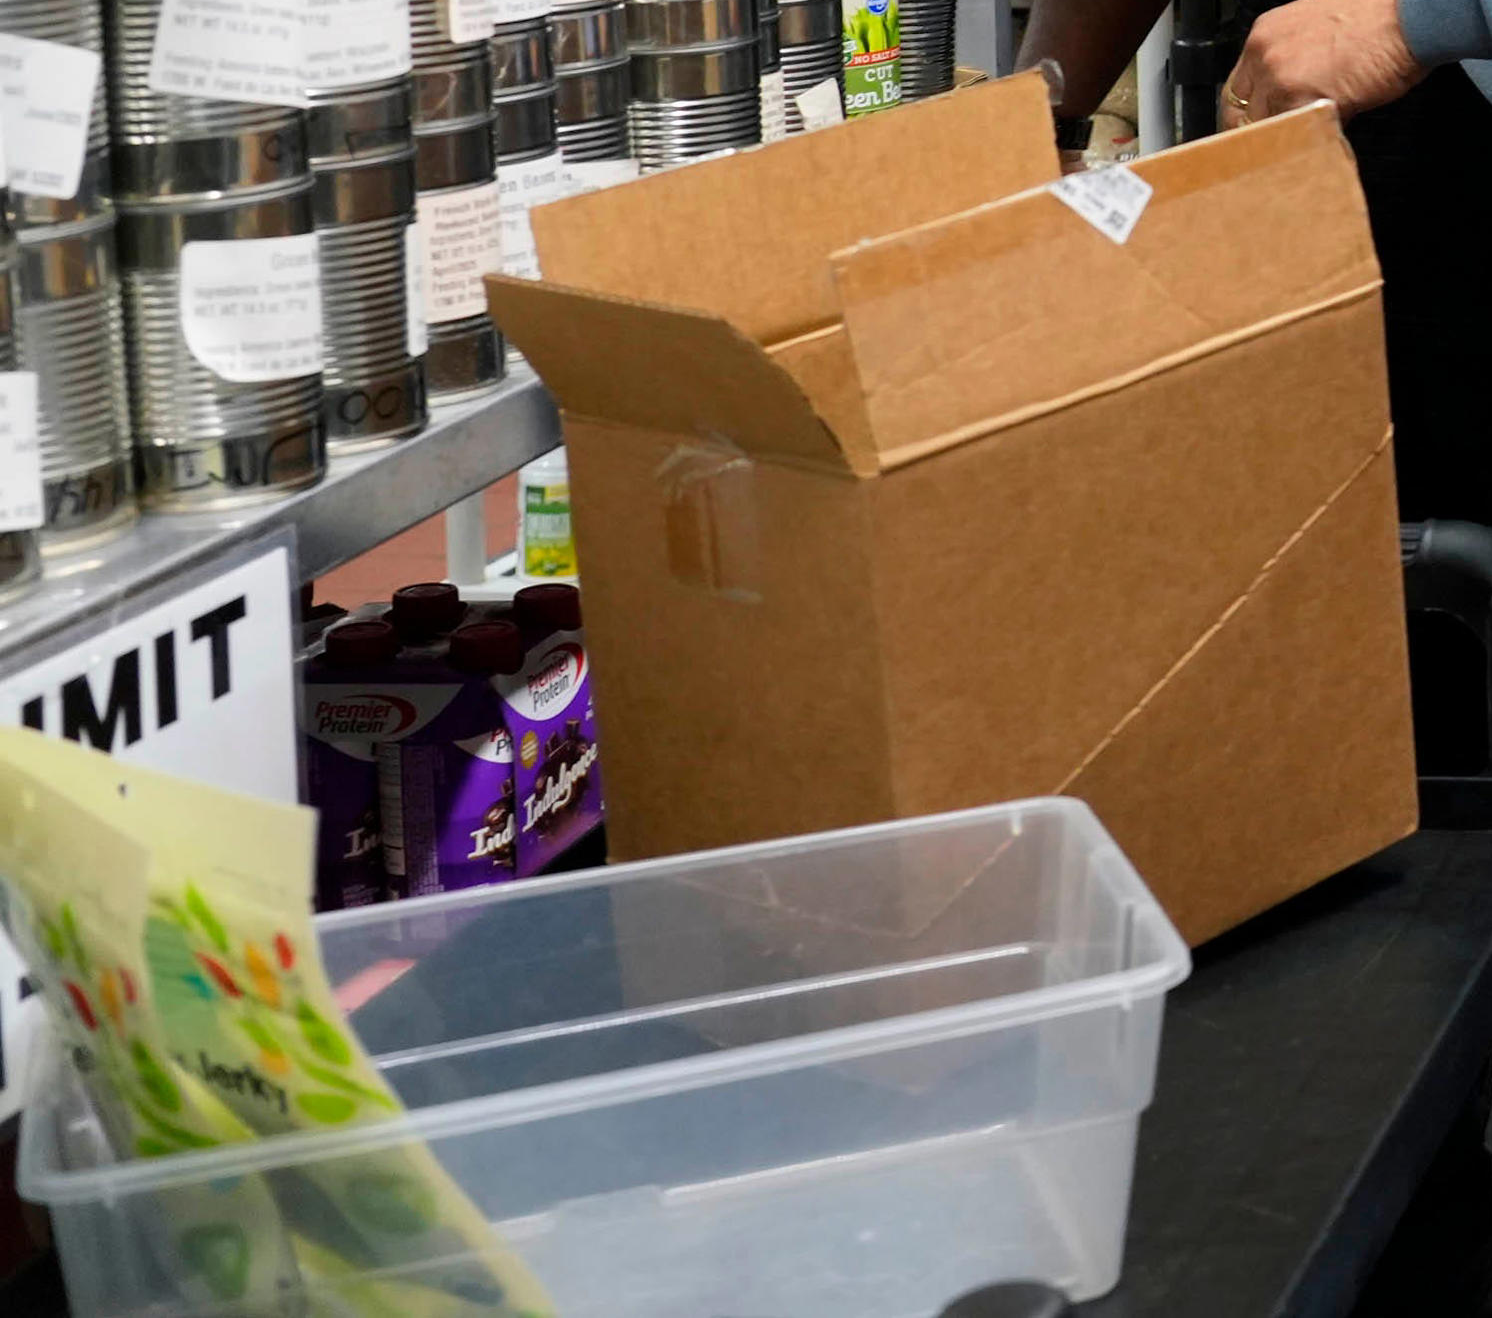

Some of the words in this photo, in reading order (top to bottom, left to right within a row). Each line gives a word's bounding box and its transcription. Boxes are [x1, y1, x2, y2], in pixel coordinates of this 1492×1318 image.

[853, 54, 870, 65] NO
[871, 51, 890, 62] SALT
[864, 65, 894, 82] CUT
[845, 91, 881, 110] een
[22, 593, 248, 755] MIT
[527, 652, 571, 695] Premier
[531, 673, 571, 713] Protein
[314, 701, 394, 720] Premier
[318, 716, 385, 734] Protein
